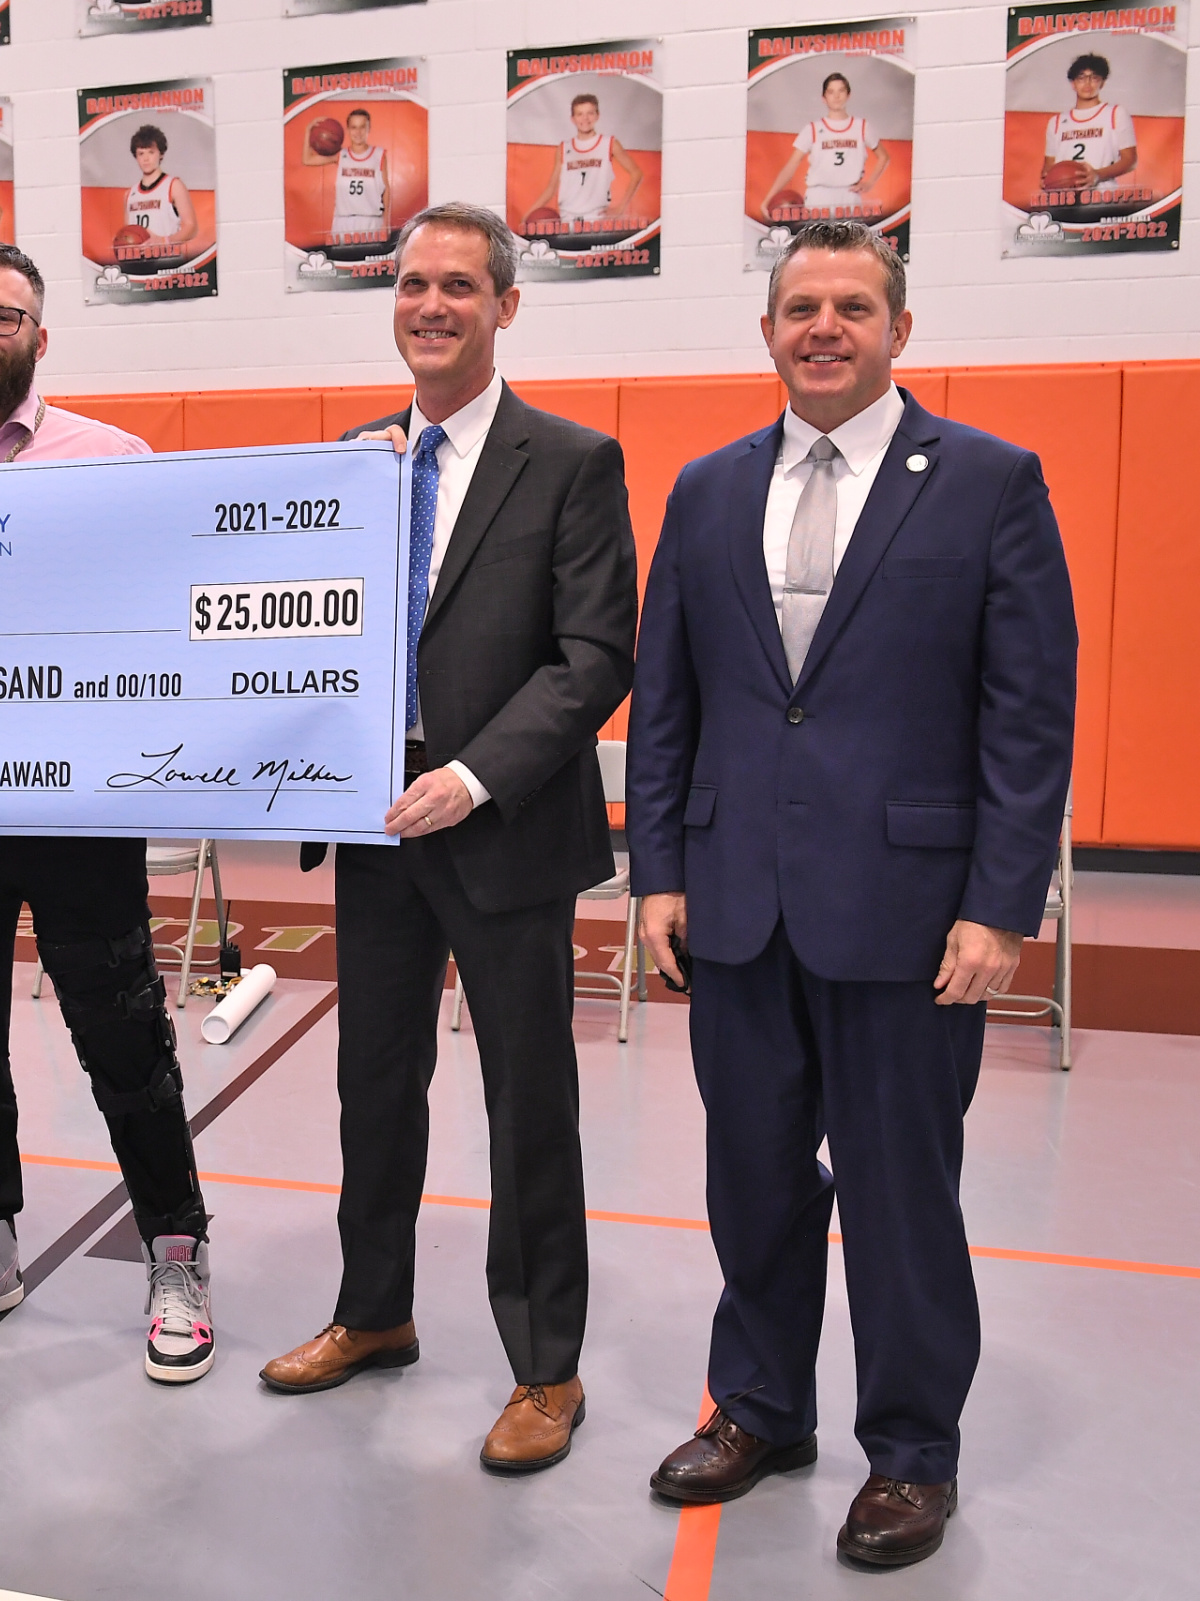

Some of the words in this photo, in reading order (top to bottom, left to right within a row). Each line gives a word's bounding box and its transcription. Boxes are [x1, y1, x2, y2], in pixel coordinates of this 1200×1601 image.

[1018, 6, 1177, 36] BALLYSHANNON
[758, 29, 905, 56] BALLYSHANNON
[517, 50, 653, 77] BALLYSHANNON
[292, 67, 418, 95] BALLYSHANNON
[86, 88, 204, 115] BALLYSHANNON
[834, 152, 844, 166] 3
[1072, 143, 1085, 161] 2
[349, 180, 364, 196] 55
[136, 214, 150, 229] 10
[772, 207, 830, 222] CARSON
[1082, 221, 1168, 242] 2021-2022
[351, 260, 395, 278] 2021-2
[575, 249, 650, 268] 2021-2022
[144, 272, 209, 291] 2021-2022
[214, 498, 341, 532] 2021-2022
[194, 588, 359, 634] $25,000.00
[73, 674, 109, 698] and
[116, 672, 182, 698] 00/100
[231, 669, 360, 695] DOLLARS
[0, 761, 71, 787] AWARD
[106, 743, 241, 789] Lowell
[166, 1245, 193, 1262] FORC
